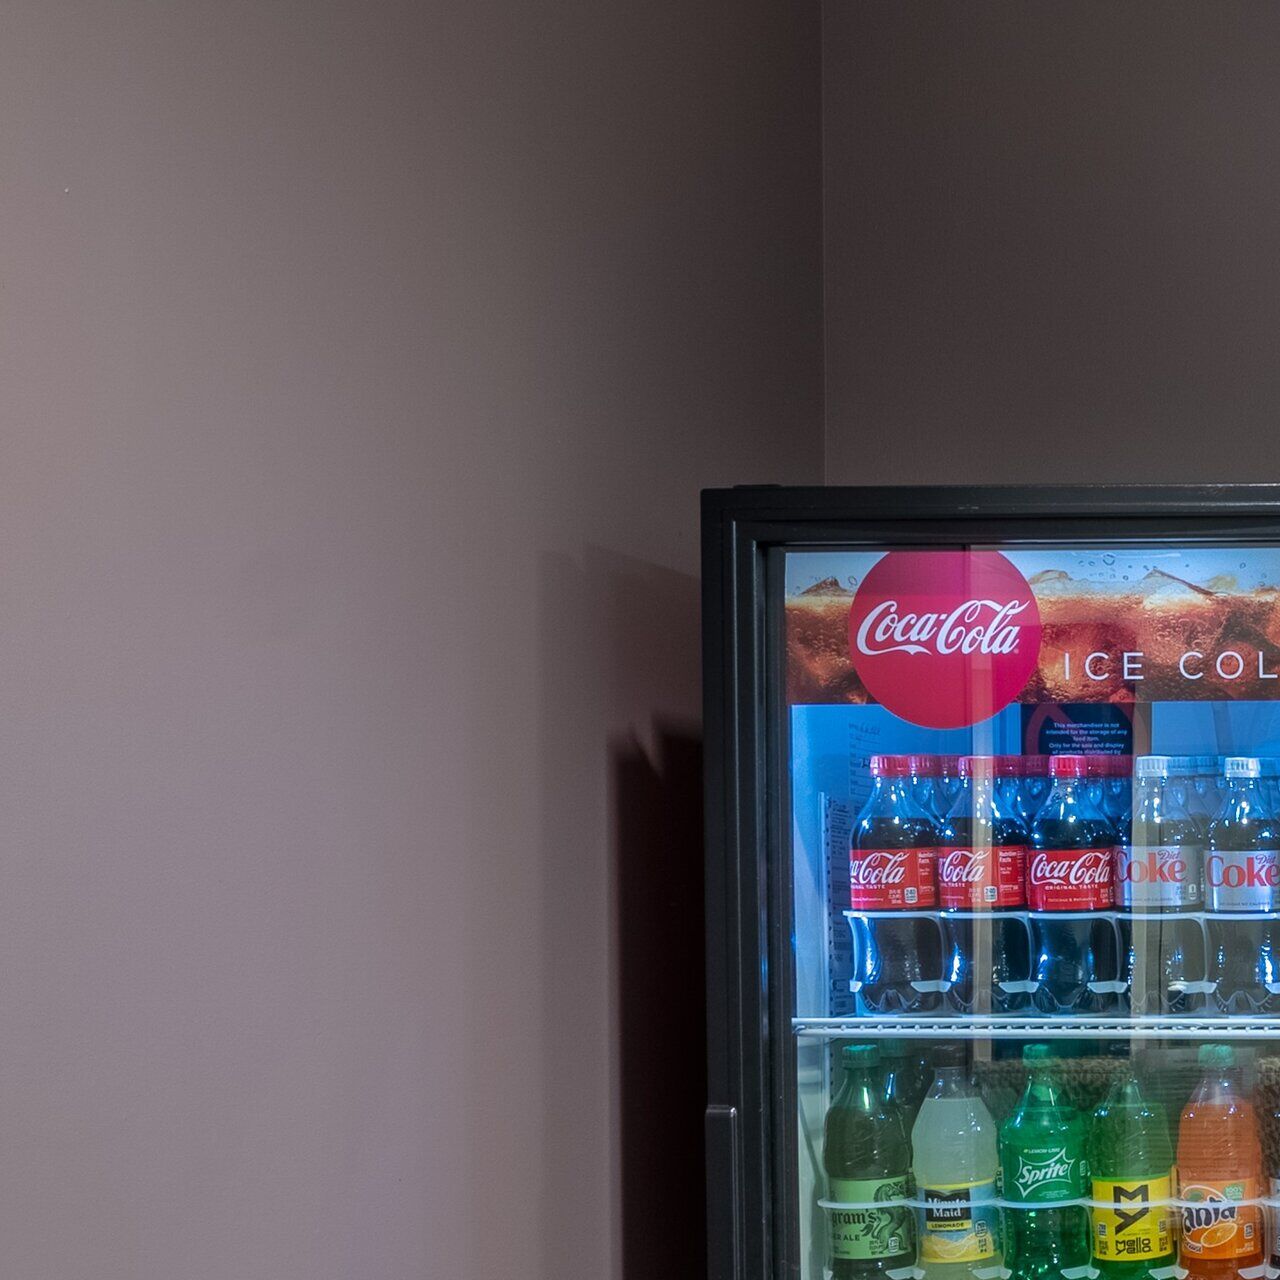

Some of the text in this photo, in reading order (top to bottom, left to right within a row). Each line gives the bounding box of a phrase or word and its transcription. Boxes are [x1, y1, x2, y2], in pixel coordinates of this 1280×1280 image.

[857, 598, 1030, 657] Coca-Cola
[1064, 652, 1145, 680] ICE
[1031, 852, 1114, 885] Coca-Cola
[1115, 850, 1187, 884] Coke
[1205, 855, 1280, 888] Coke
[1255, 854, 1277, 866] Diet
[1020, 1162, 1070, 1185] Sprite
[933, 1207, 962, 1218] Maid
[842, 1233, 861, 1242] ALE
